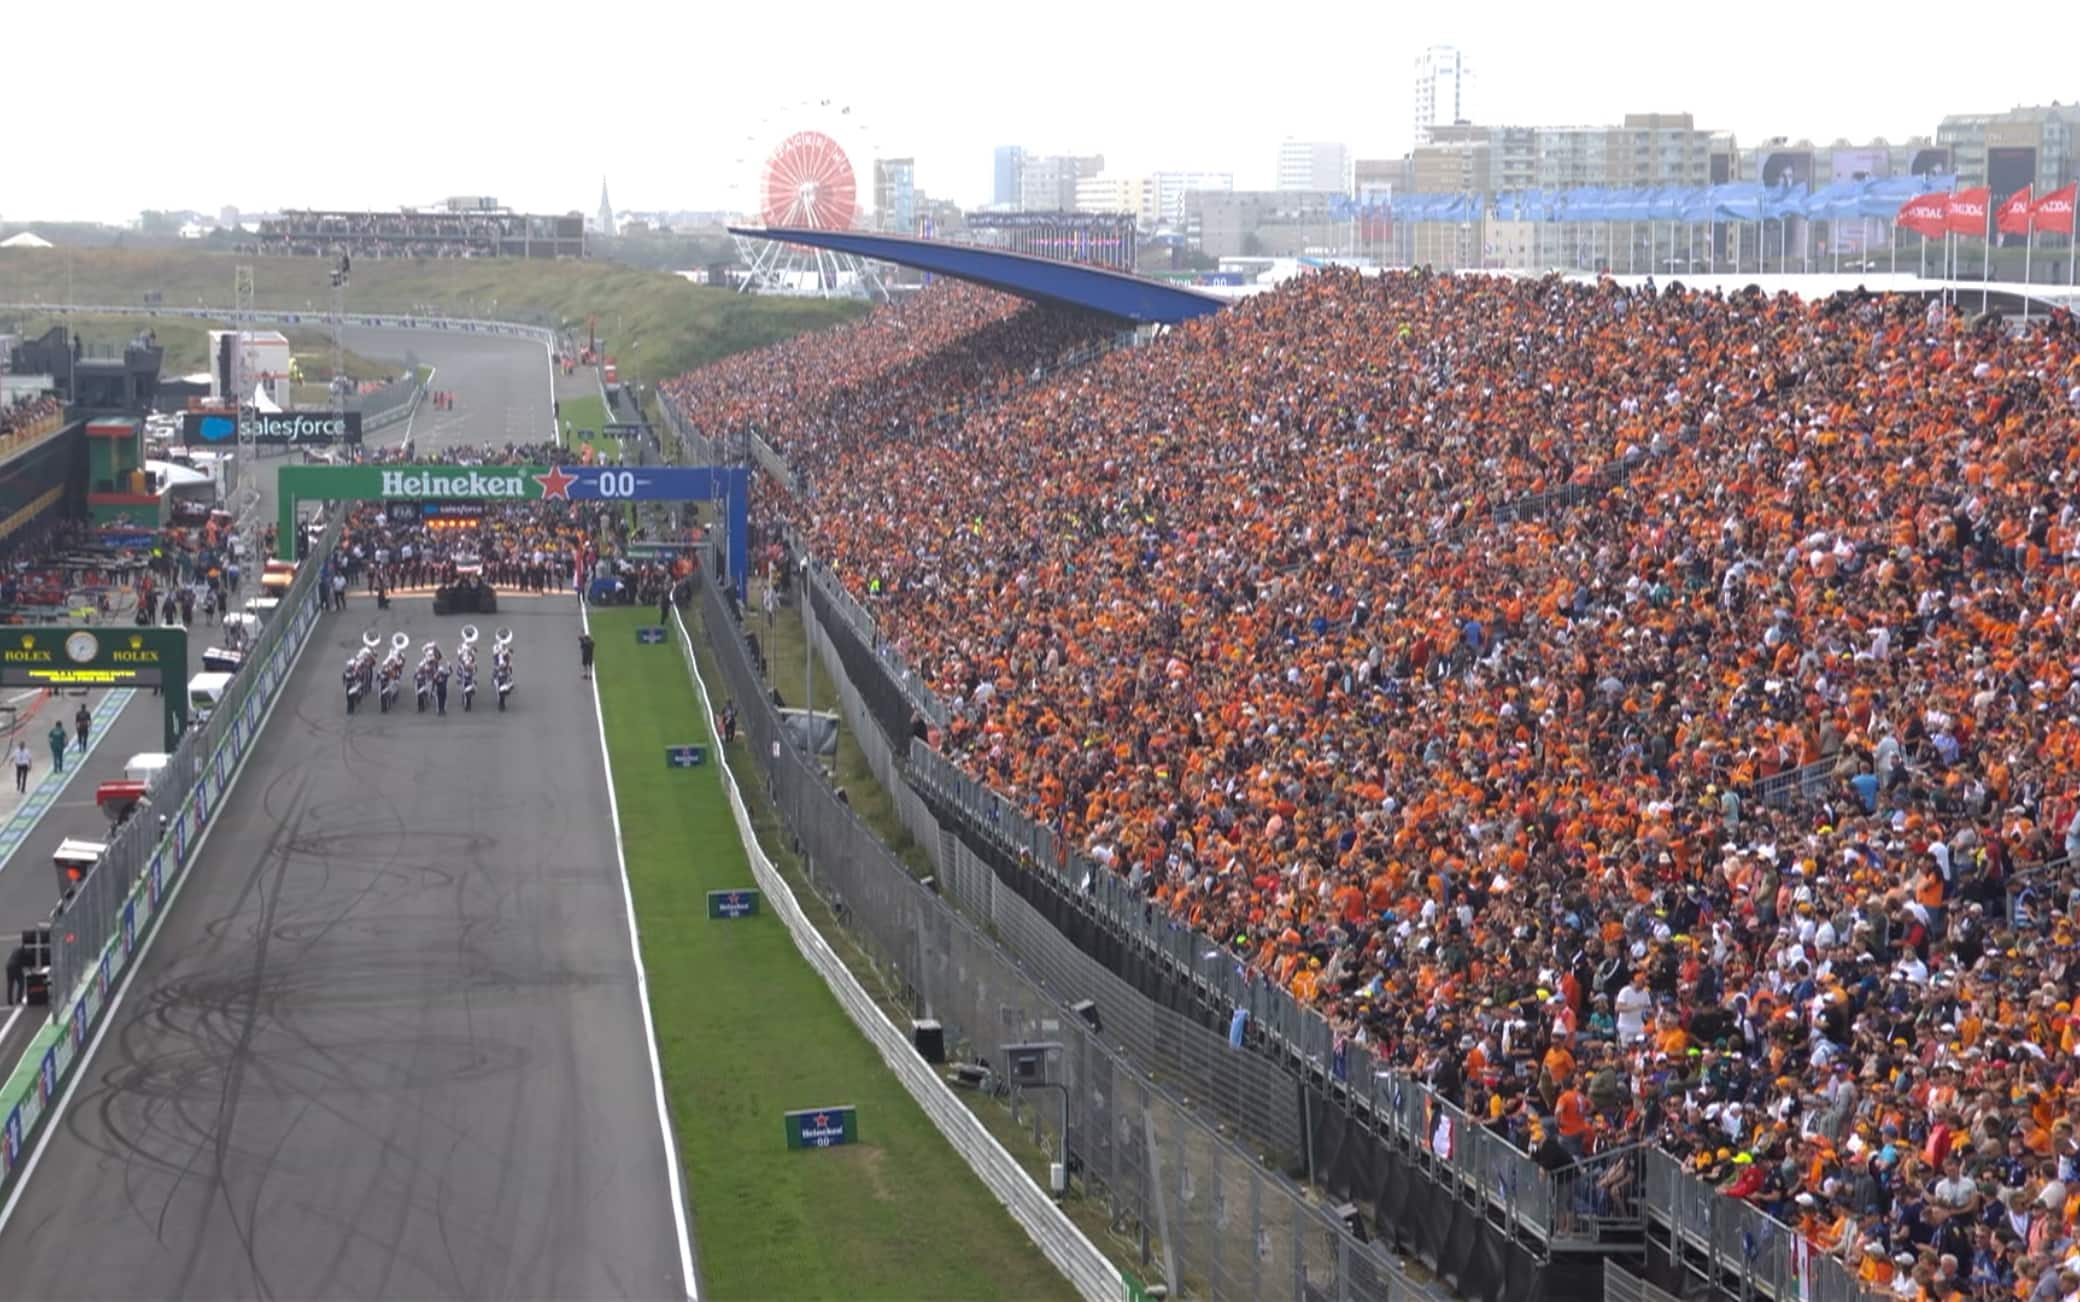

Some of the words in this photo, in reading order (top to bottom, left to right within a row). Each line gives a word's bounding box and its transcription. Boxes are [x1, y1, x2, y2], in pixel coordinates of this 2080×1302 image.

[240, 415, 345, 441] salesforce
[381, 471, 525, 497] Heineken
[5, 651, 51, 662] ROLEX
[113, 651, 159, 662] ROLEX
